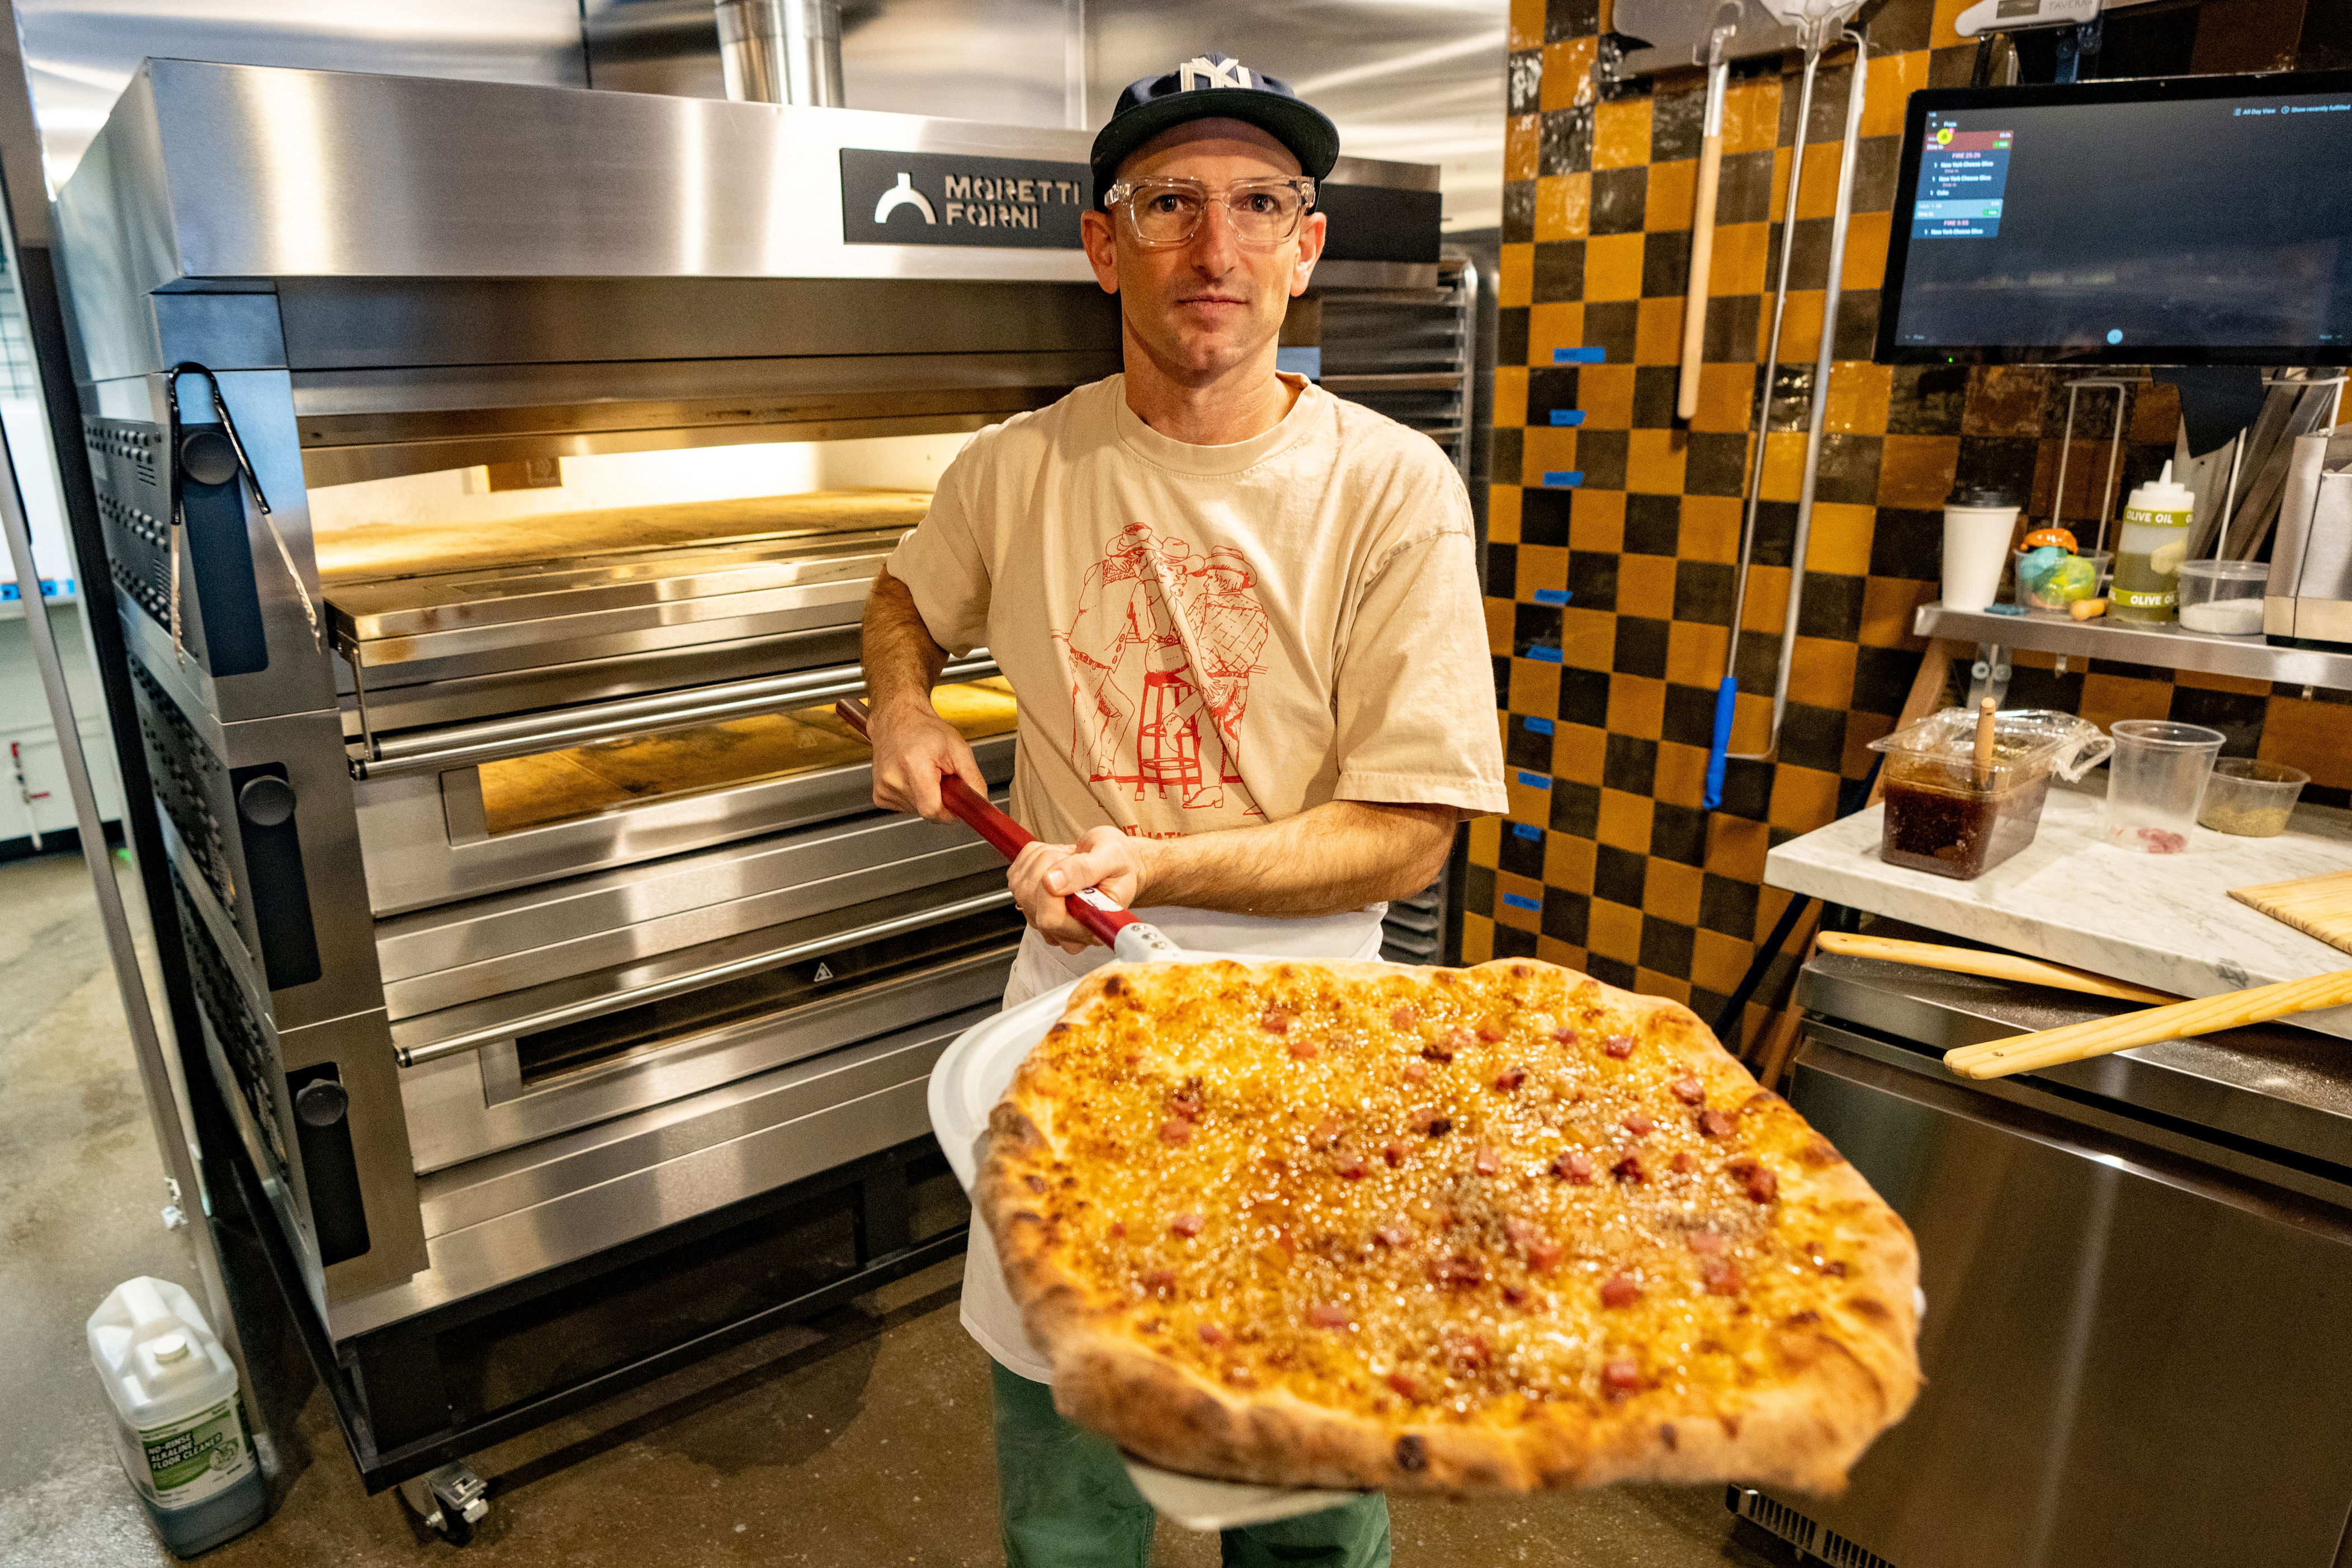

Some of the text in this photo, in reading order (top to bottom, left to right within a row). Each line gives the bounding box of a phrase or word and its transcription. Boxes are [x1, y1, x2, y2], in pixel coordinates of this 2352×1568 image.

[945, 175, 1080, 205] MORETTI
[946, 202, 1038, 229] FORNI
[2127, 511, 2151, 523] OLIVE
[2155, 513, 2172, 523] OIL
[2130, 595, 2162, 606] OLIVE
[152, 1454, 182, 1470] FLOOR
[182, 1432, 222, 1460] CLEANER
